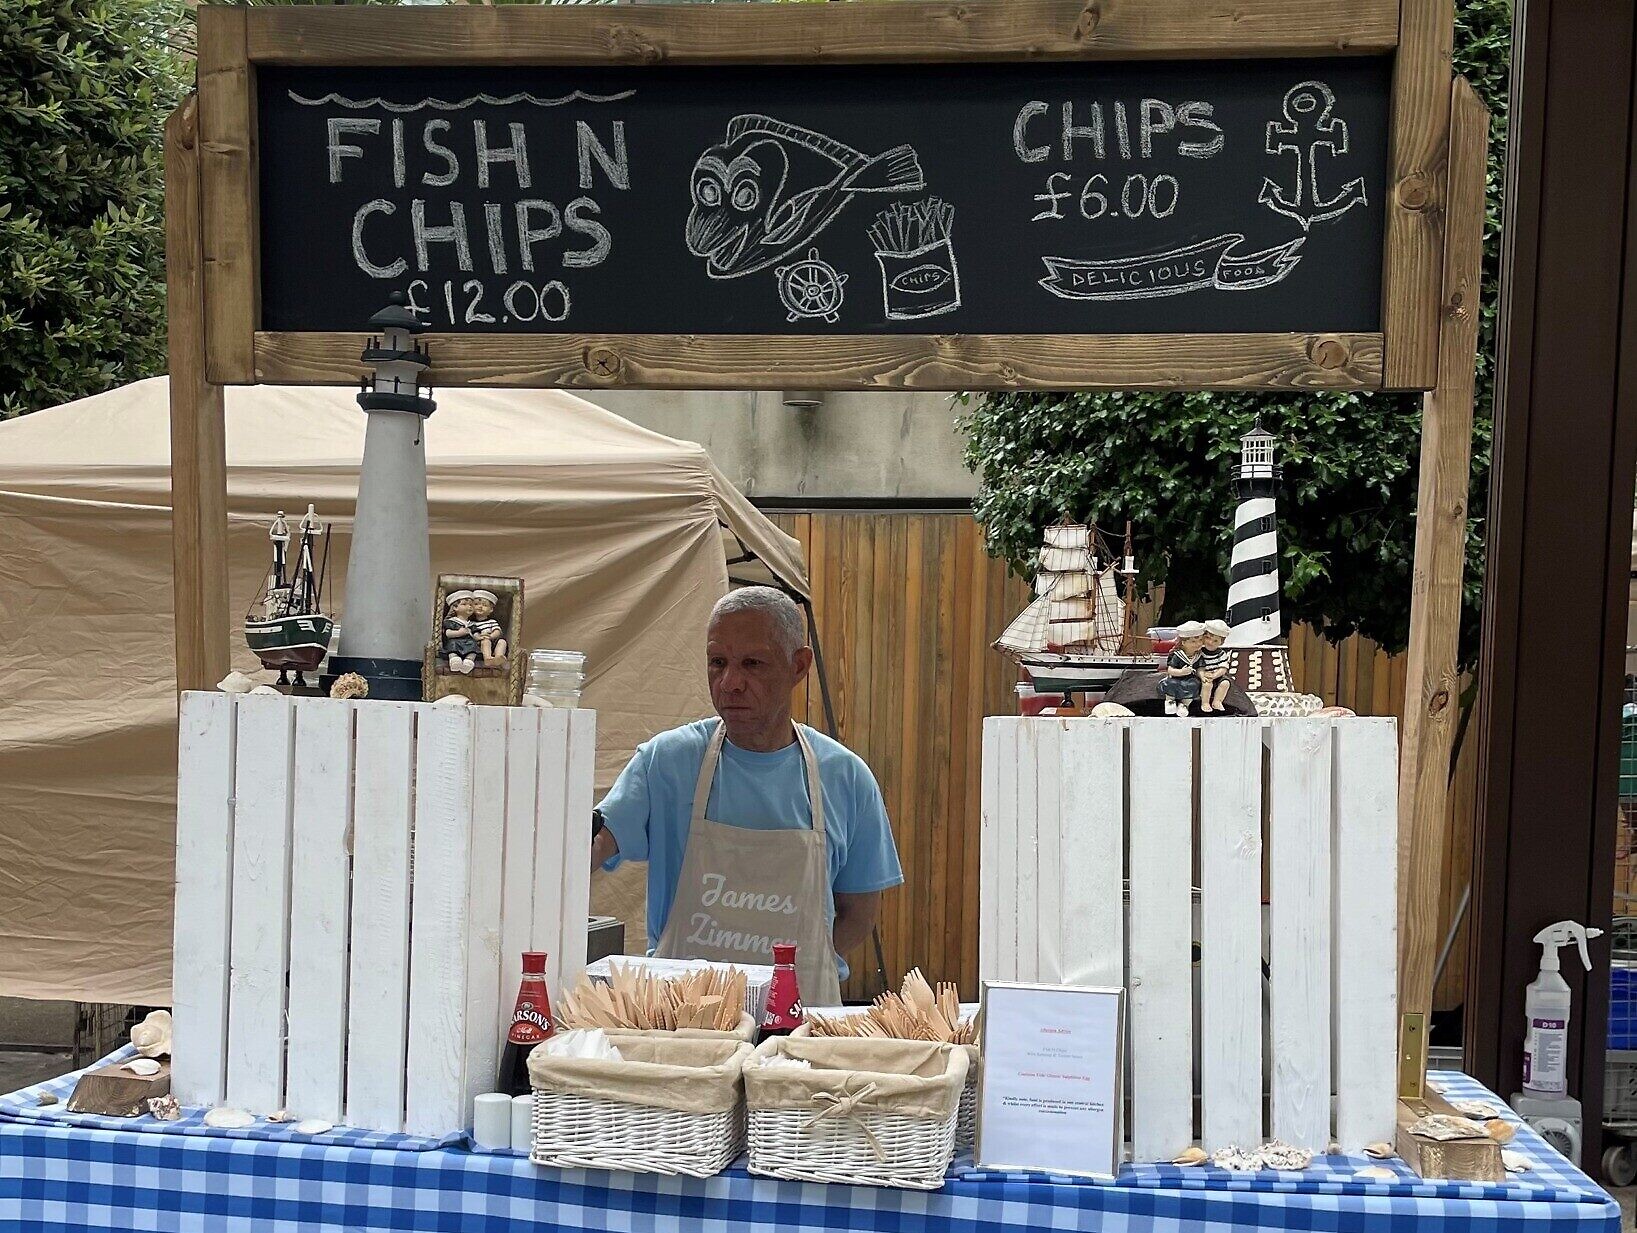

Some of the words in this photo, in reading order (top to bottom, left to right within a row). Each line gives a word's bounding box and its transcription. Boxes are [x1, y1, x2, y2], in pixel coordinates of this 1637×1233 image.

[326, 118, 531, 189] FISH
[576, 119, 630, 190] N
[1013, 99, 1225, 163] CHIPS
[1032, 172, 1180, 222] £6.00
[351, 196, 612, 279] CHIPS
[901, 271, 940, 285] CHIPS
[1072, 260, 1205, 286] DELICIOUS
[1222, 268, 1265, 279] FOOD
[404, 279, 572, 326] £12.00
[701, 873, 798, 915] James
[511, 1010, 551, 1031] ARSON'S
